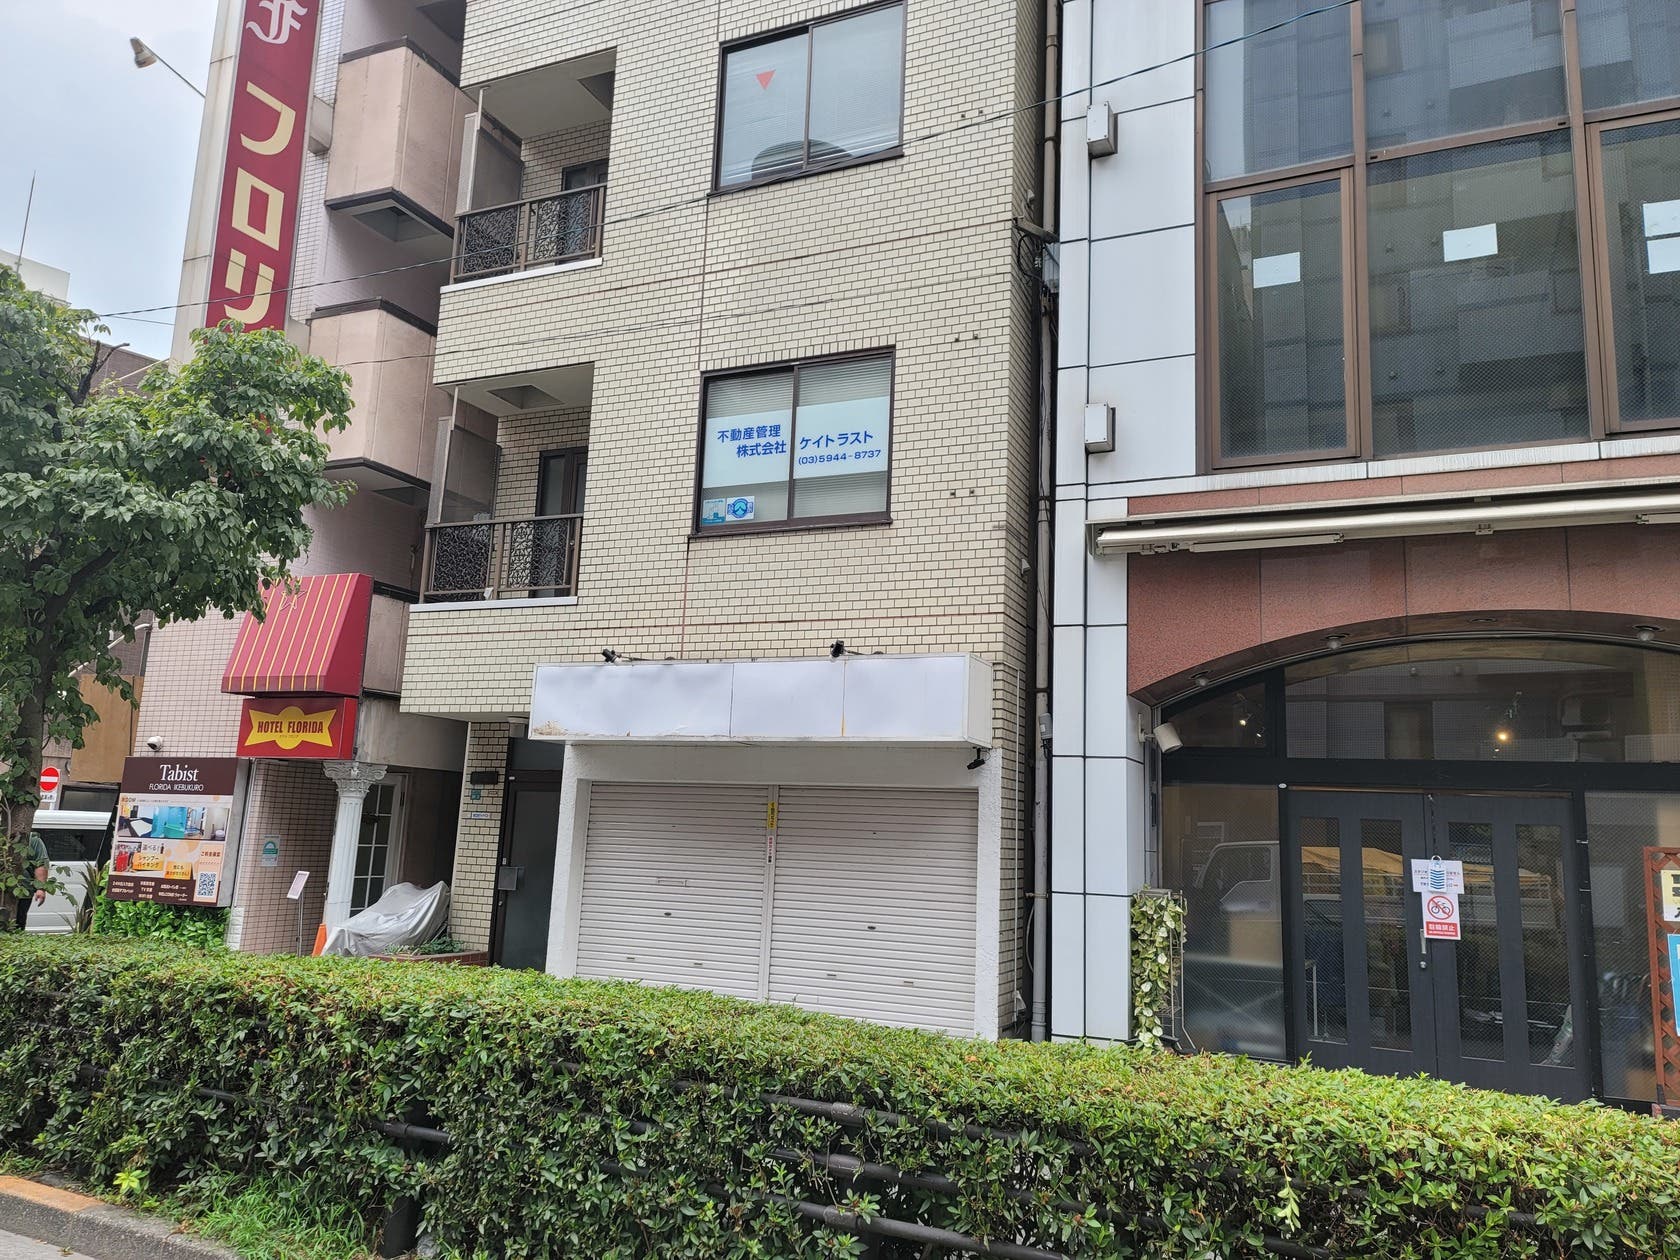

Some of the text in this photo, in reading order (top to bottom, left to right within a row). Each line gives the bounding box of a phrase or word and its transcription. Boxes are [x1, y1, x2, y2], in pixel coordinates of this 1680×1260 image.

[717, 424, 781, 443] 不動産管理
[736, 431, 874, 458] 株式会社 ケイトラスト
[798, 449, 881, 465] (03)5944-8737
[257, 721, 323, 733] HOTEL FLORIDA
[160, 764, 199, 781] Tabist
[148, 783, 204, 791] FLORIDA IKEBUKURO
